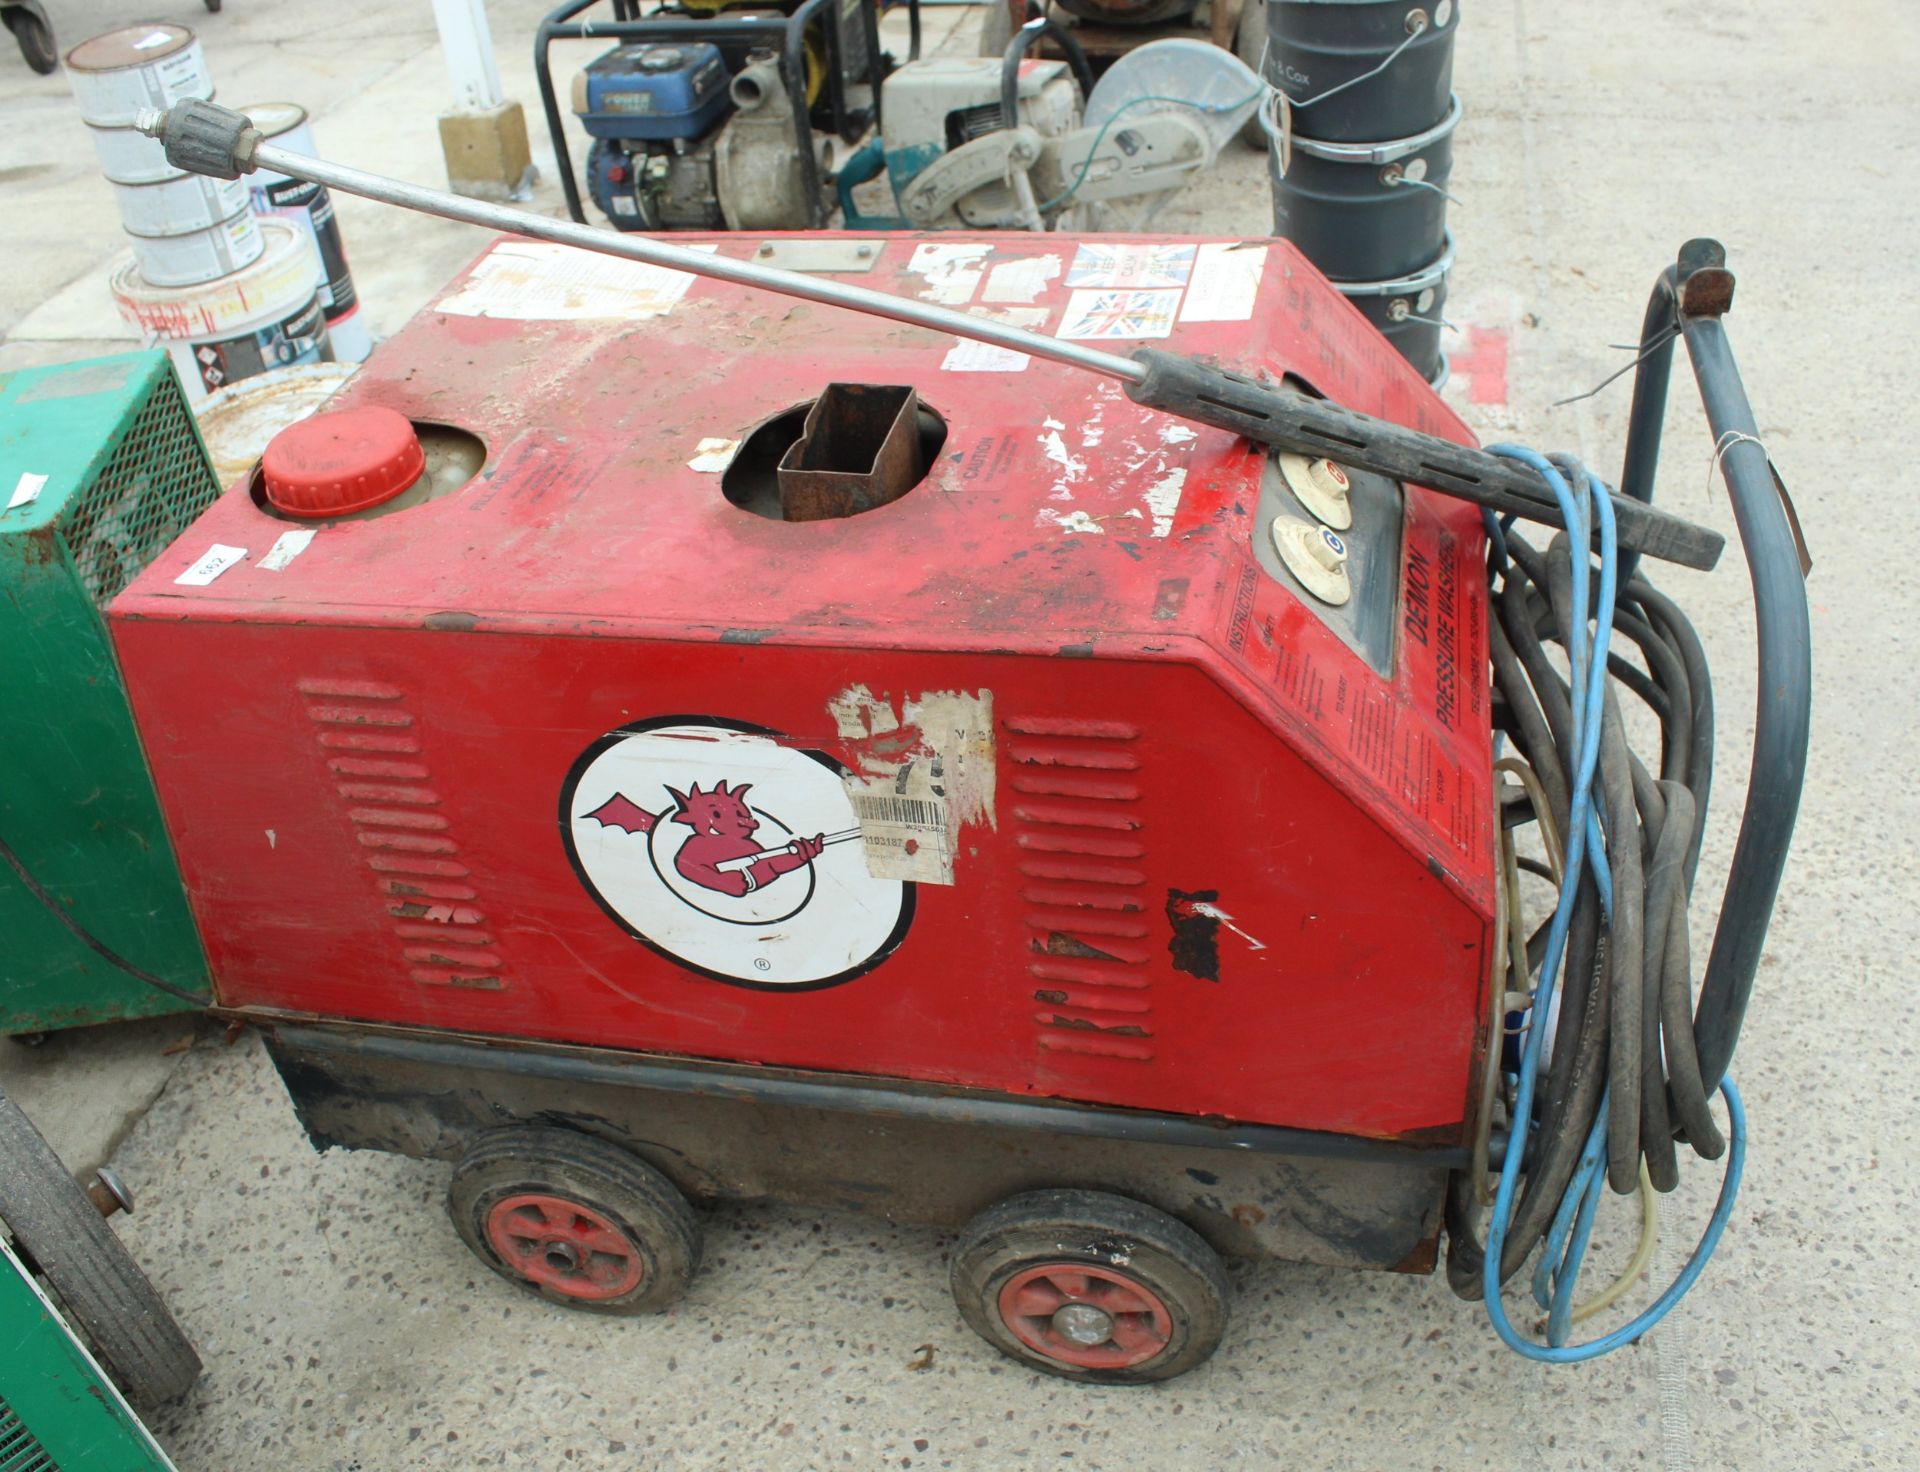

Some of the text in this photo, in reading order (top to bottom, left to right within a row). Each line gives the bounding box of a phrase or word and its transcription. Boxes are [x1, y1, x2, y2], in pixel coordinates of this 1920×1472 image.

[1285, 65, 1311, 86] Cox
[963, 436, 995, 480] CAUTION
[1229, 564, 1257, 652] INSTRUCTIONS
[1405, 544, 1429, 647] DEMON
[1437, 528, 1455, 733] PRESSURE WASHERS
